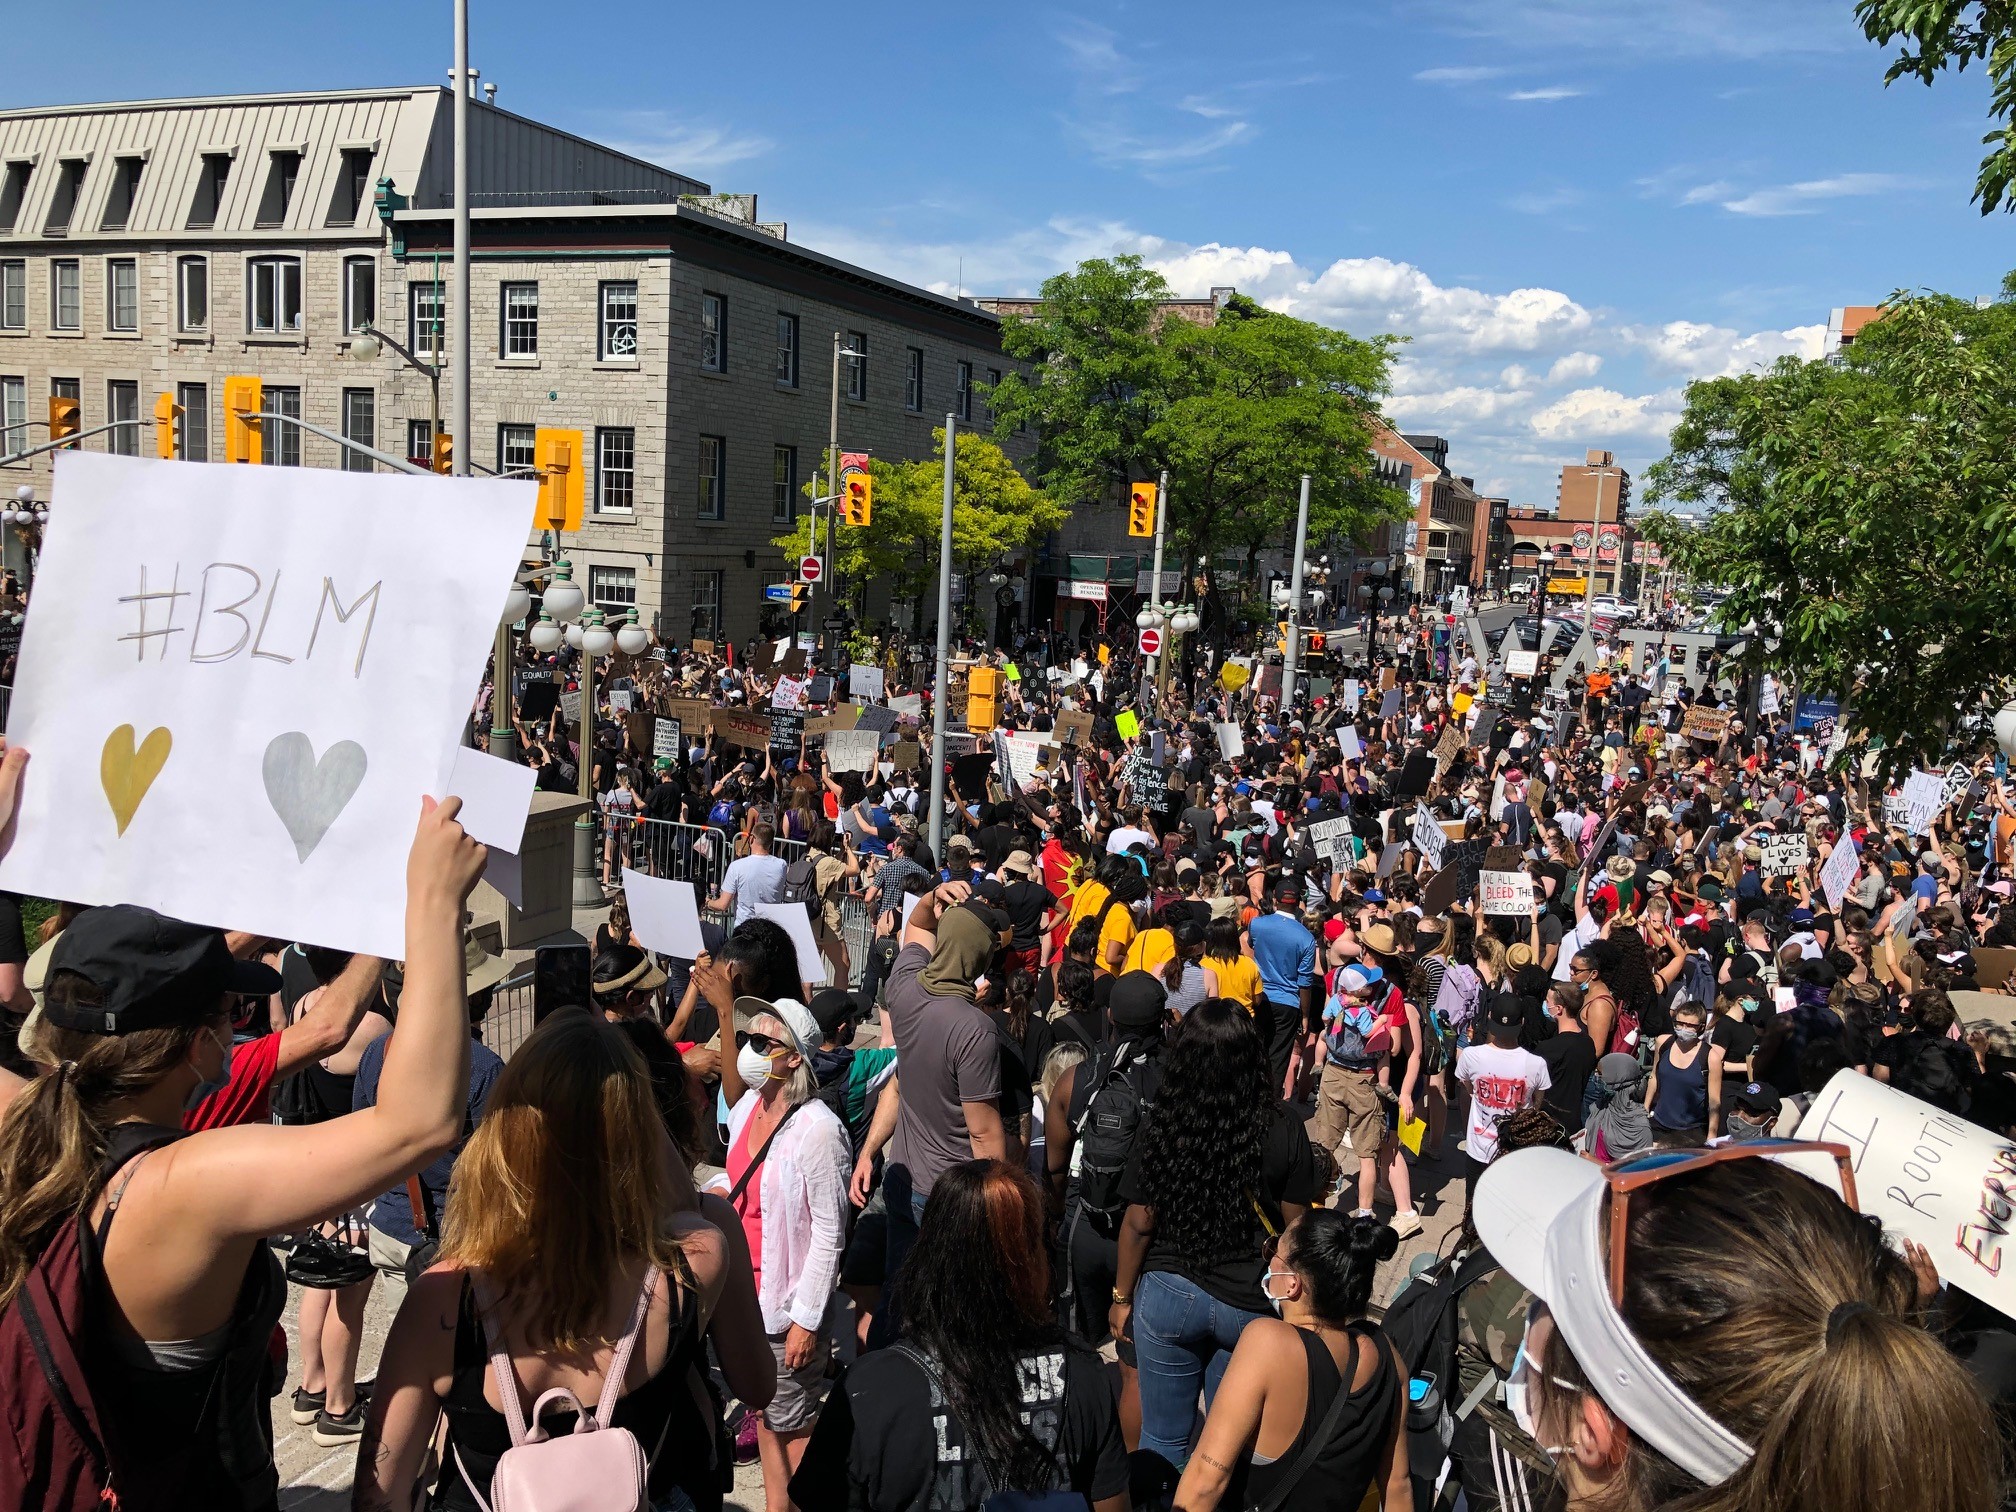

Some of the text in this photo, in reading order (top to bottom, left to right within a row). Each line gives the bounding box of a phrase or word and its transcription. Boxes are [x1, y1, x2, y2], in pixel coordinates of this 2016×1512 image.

[118, 561, 382, 679] #BLM
[522, 670, 552, 680] EQUALITY
[1800, 712, 1825, 720] Mackenzie
[727, 715, 769, 736] JUSTICE
[1813, 718, 1833, 732] PIGS
[834, 745, 872, 759] LIVES
[1132, 746, 1144, 757] NO
[1416, 810, 1444, 865] ENOUGH
[1760, 834, 1806, 850] BLACK
[1768, 847, 1802, 858] LIVES
[1761, 864, 1798, 878] MATTE
[1482, 872, 1515, 885] WE ALL
[1486, 886, 1533, 900] BLEED THE
[1481, 900, 1535, 913] SAME COLOUR
[1477, 1078, 1526, 1104] BLM
[1886, 1112, 1969, 1220] ROOTIN
